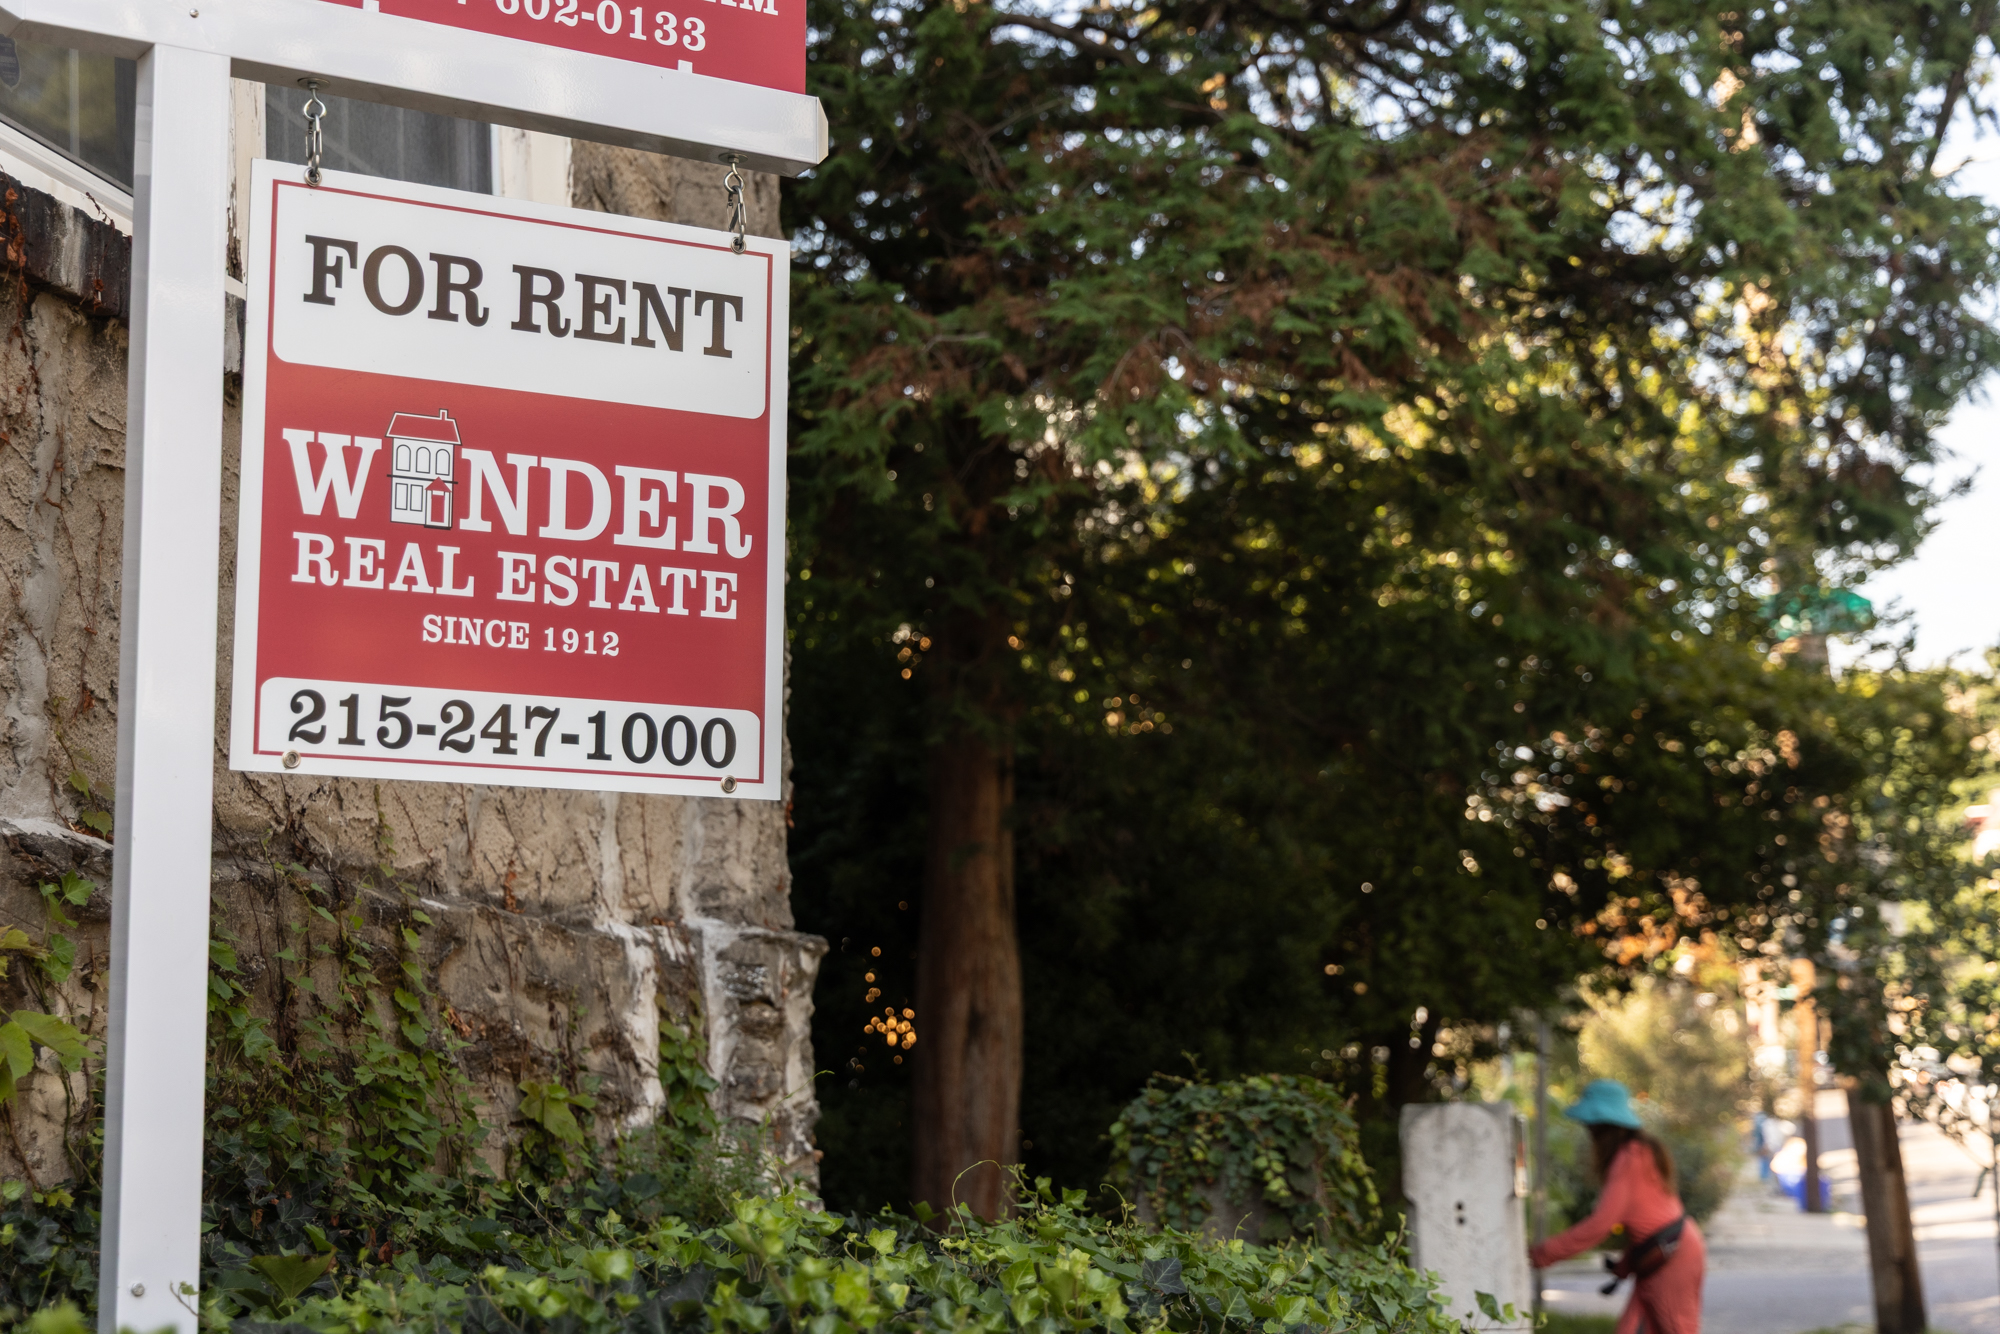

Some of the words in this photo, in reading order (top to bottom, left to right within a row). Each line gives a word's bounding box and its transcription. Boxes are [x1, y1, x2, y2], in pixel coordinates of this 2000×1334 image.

[303, 234, 490, 327] FOR
[510, 264, 744, 359] RENT
[281, 427, 754, 559] WNDER
[291, 531, 475, 598] REAL
[496, 551, 738, 620] ESTATE
[422, 613, 530, 650] SINCE
[543, 626, 621, 657] 1912
[288, 689, 738, 769] 215-247-1000
